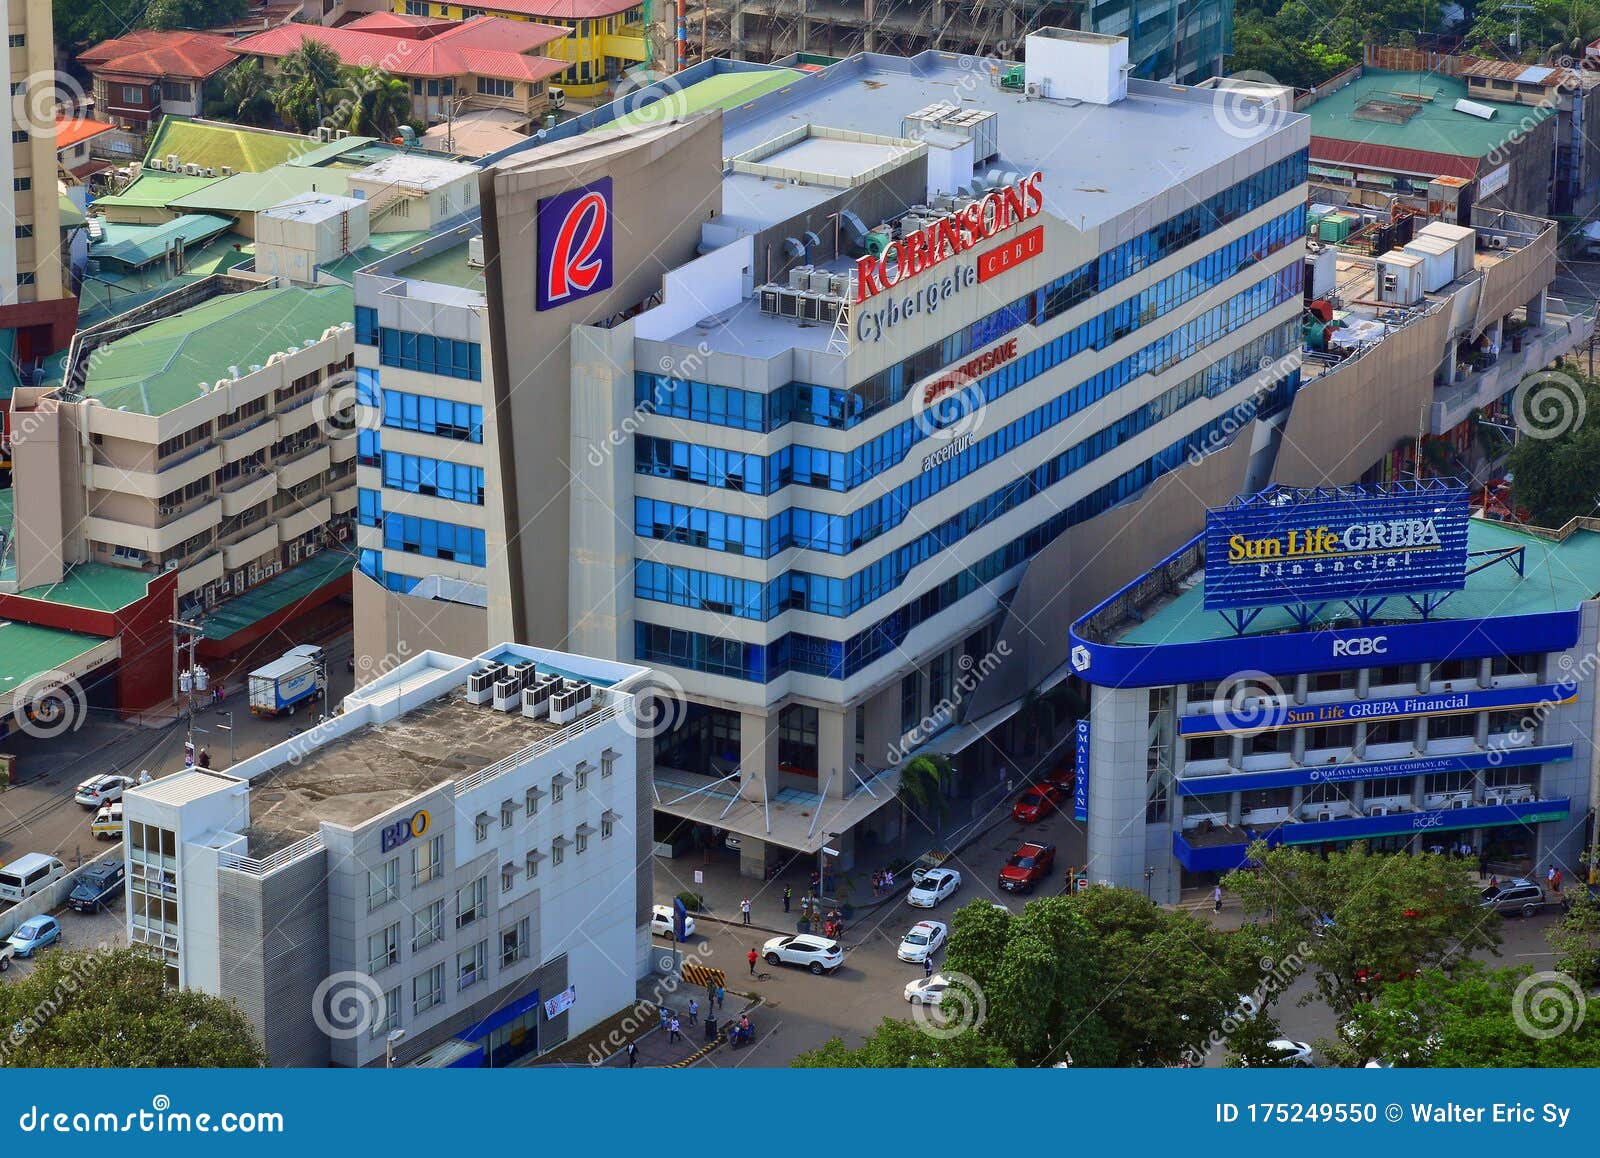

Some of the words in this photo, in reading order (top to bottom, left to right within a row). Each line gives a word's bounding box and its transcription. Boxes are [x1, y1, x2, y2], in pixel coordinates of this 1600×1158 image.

[855, 171, 1043, 304] ROBINSONS
[857, 264, 977, 342] Cybergate
[988, 236, 1036, 272] CEBU
[921, 431, 976, 472] accenture
[1228, 533, 1282, 561] Sun
[1286, 526, 1340, 556] Life
[1343, 519, 1442, 551] GREPA
[1259, 553, 1411, 577] Financial
[1333, 636, 1388, 657] RCBC
[1288, 710, 1315, 723] Sun
[1319, 706, 1345, 720] Life
[1349, 702, 1400, 718] GREPA
[1404, 694, 1470, 713] Financial
[1077, 734, 1088, 806] MALAYAN
[1320, 767, 1356, 778] MALAYAN
[1357, 764, 1399, 774] INSURANCE
[381, 810, 431, 854] BDO
[1412, 816, 1444, 829] RCBC
